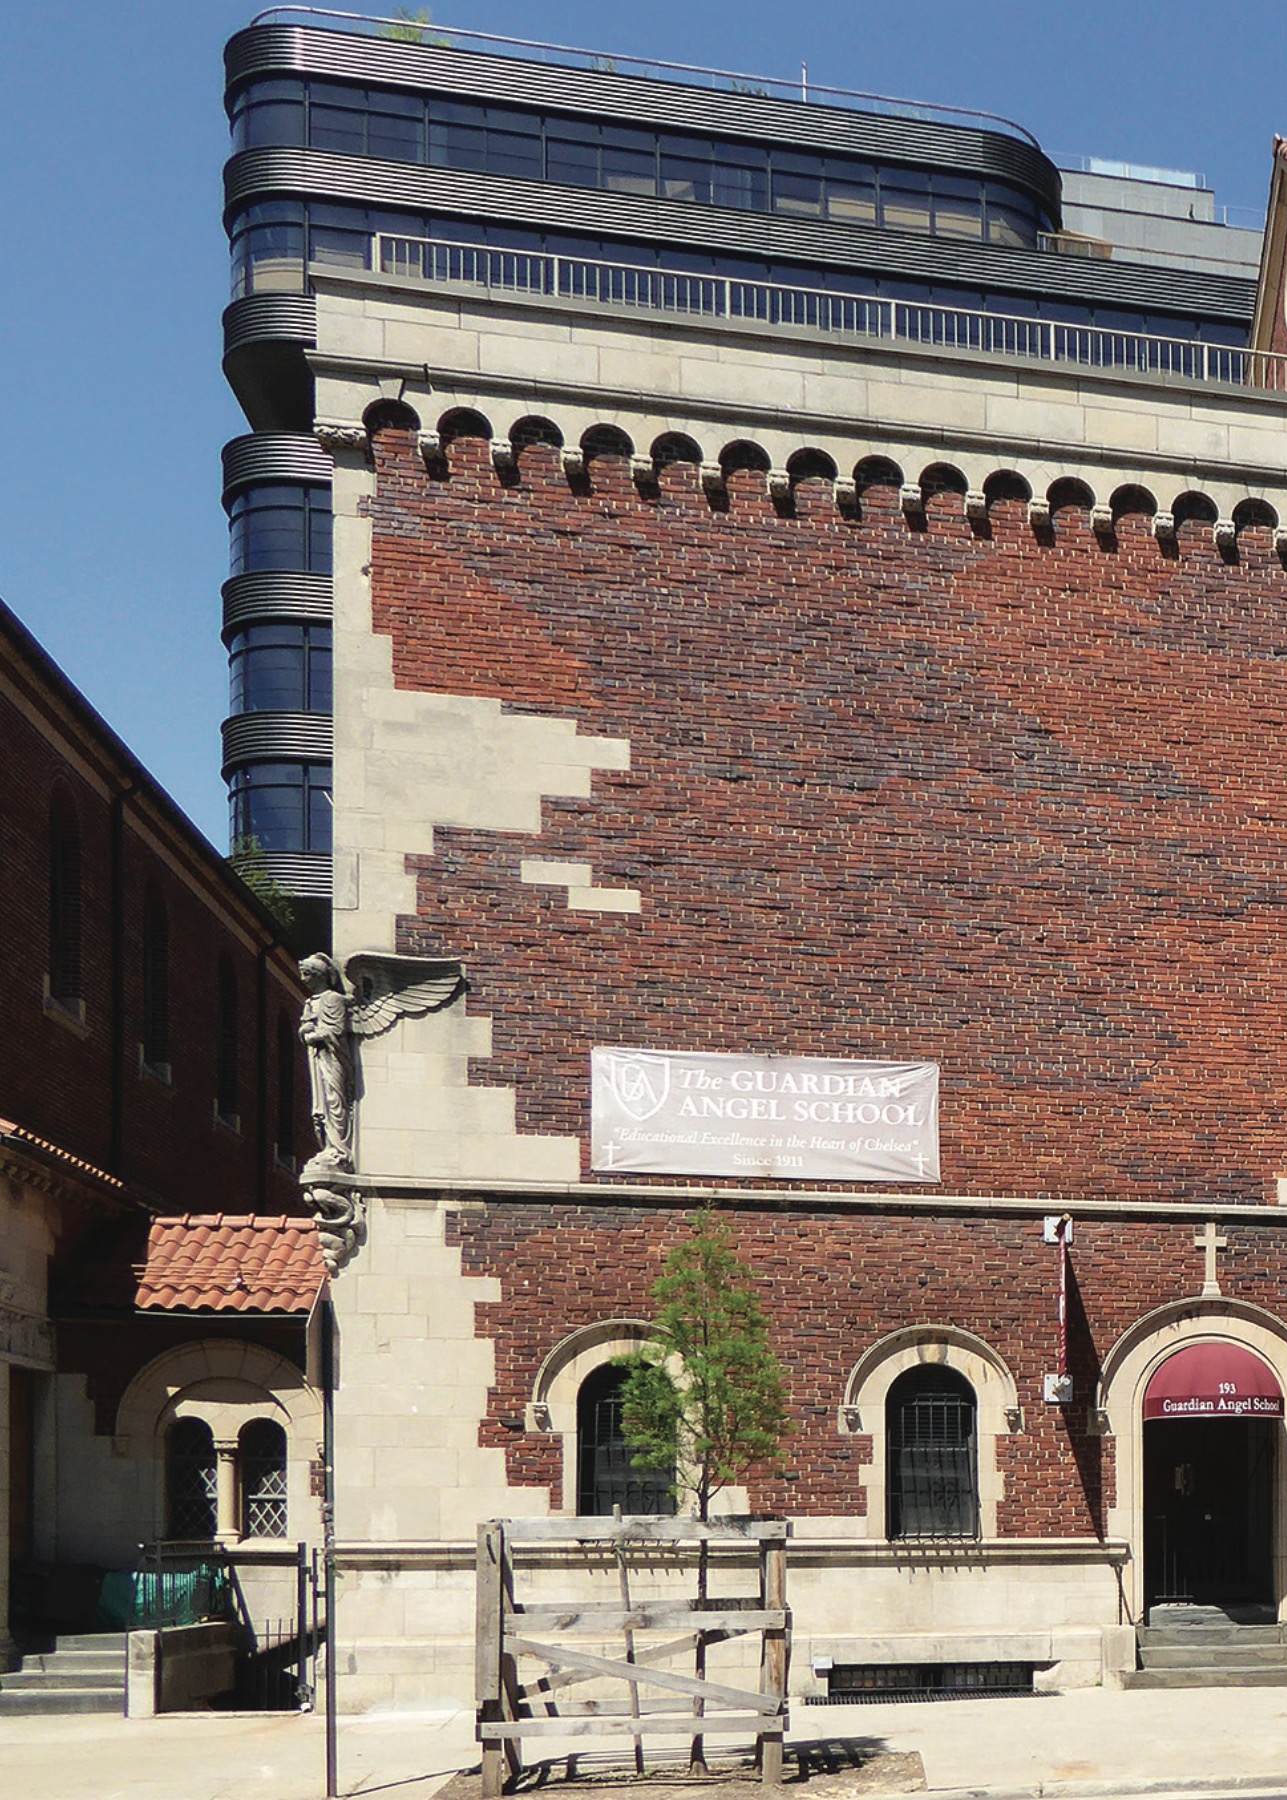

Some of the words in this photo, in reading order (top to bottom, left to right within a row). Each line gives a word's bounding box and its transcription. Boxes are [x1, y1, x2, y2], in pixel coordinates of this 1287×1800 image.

[679, 1068, 723, 1090] The
[731, 1070, 901, 1098] GUARDIAN
[677, 1095, 786, 1120] ANGEL
[794, 1100, 924, 1126] SCHOOL
[701, 1132, 767, 1146] Excellence
[770, 1134, 783, 1147] in
[787, 1134, 807, 1149] the
[810, 1136, 845, 1150] Heart
[849, 1137, 863, 1153] of
[732, 1153, 772, 1166] Since
[775, 1155, 803, 1167] 1911
[1218, 1382, 1236, 1394] 193
[1163, 1398, 1214, 1413] Guardian
[1217, 1397, 1251, 1413] Angel
[1253, 1398, 1280, 1411] School
